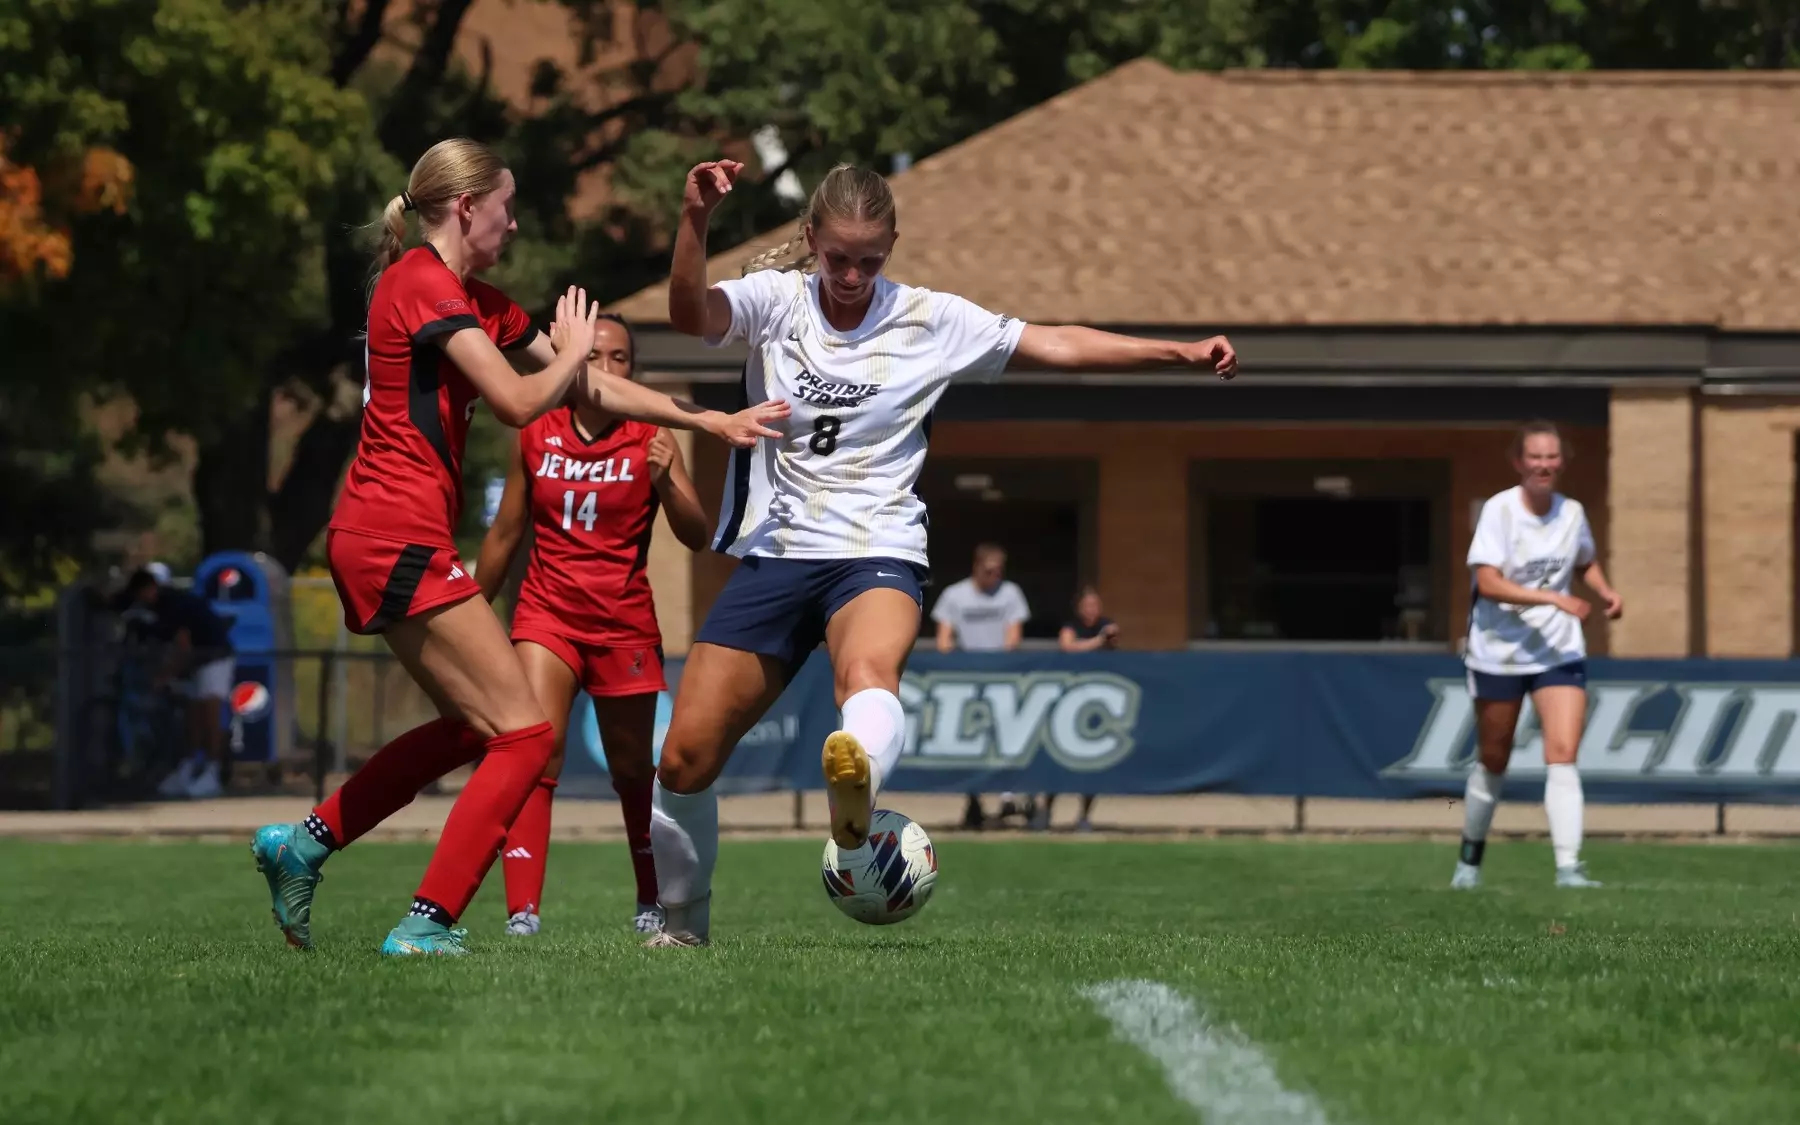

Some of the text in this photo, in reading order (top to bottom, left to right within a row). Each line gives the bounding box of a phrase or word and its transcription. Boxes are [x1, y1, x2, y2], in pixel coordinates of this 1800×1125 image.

[792, 385, 865, 408] STARS
[794, 369, 882, 396] PRAIRIE
[809, 414, 841, 456] 8
[536, 452, 634, 482] JEWELL
[562, 490, 598, 531] 14
